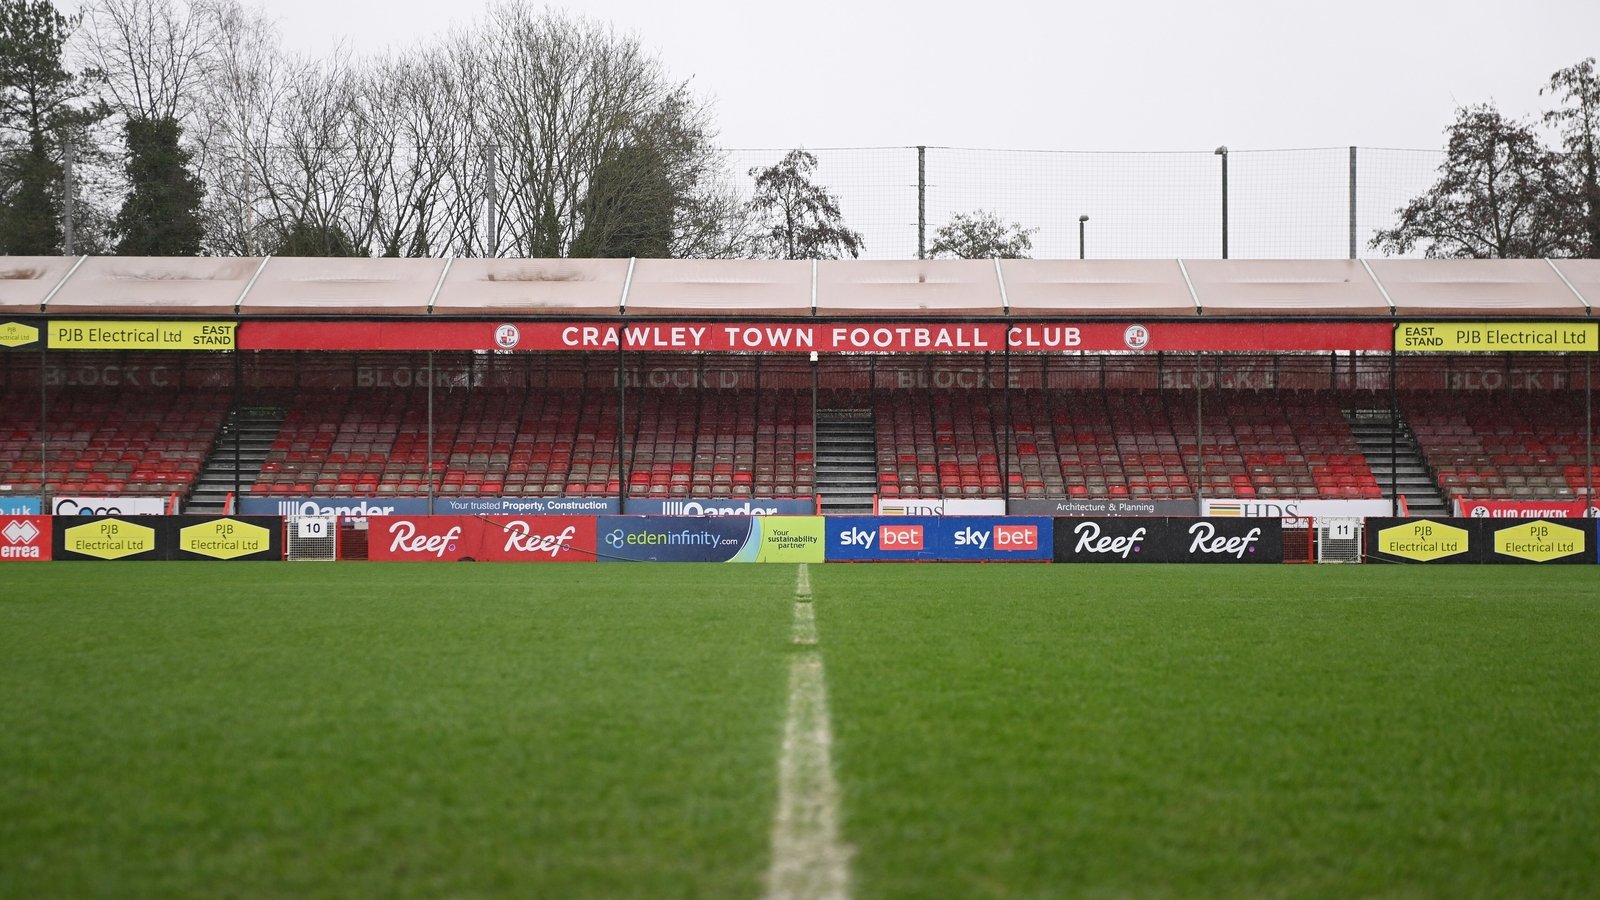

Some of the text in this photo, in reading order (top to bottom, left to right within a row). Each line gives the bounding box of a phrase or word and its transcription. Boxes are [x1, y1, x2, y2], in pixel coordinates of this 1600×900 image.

[59, 328, 182, 342] PJB Electrical Ltd
[202, 326, 231, 335] EAST
[1405, 327, 1434, 336] EAST
[192, 336, 231, 345] STAND
[561, 326, 1082, 348] CRAWLEY TOWN FOOTBALL CLUB
[1405, 337, 1444, 346] STAND
[1456, 330, 1586, 344] PJB Electrical Ltd
[45, 366, 140, 386] BLOCK
[613, 367, 740, 388] BLOCK D
[898, 368, 1021, 388] BLOCK E
[1444, 368, 1543, 389] BLOCK
[450, 501, 608, 511] Your trusted Property, Construction
[1056, 503, 1155, 513] Architecture & Planning
[1243, 503, 1298, 524] HDS
[101, 525, 118, 534] PJB
[216, 525, 234, 534] PJB
[306, 523, 321, 533] 10
[1337, 525, 1348, 535] 11
[1414, 526, 1432, 536] PJB
[1530, 526, 1548, 536] PJB
[389, 520, 462, 558] Reef
[503, 520, 576, 558] Reef
[768, 536, 818, 544] sustainability
[840, 527, 919, 549] sky bet
[954, 527, 1033, 549] sky bet
[1074, 521, 1147, 559] Reef
[1188, 521, 1261, 559] Reef
[76, 540, 144, 550] Electrical Ltd
[191, 540, 258, 550] Electrical Ltd
[1389, 542, 1457, 552] Electrical Ltd
[1505, 543, 1574, 552] Electrical Ltd
